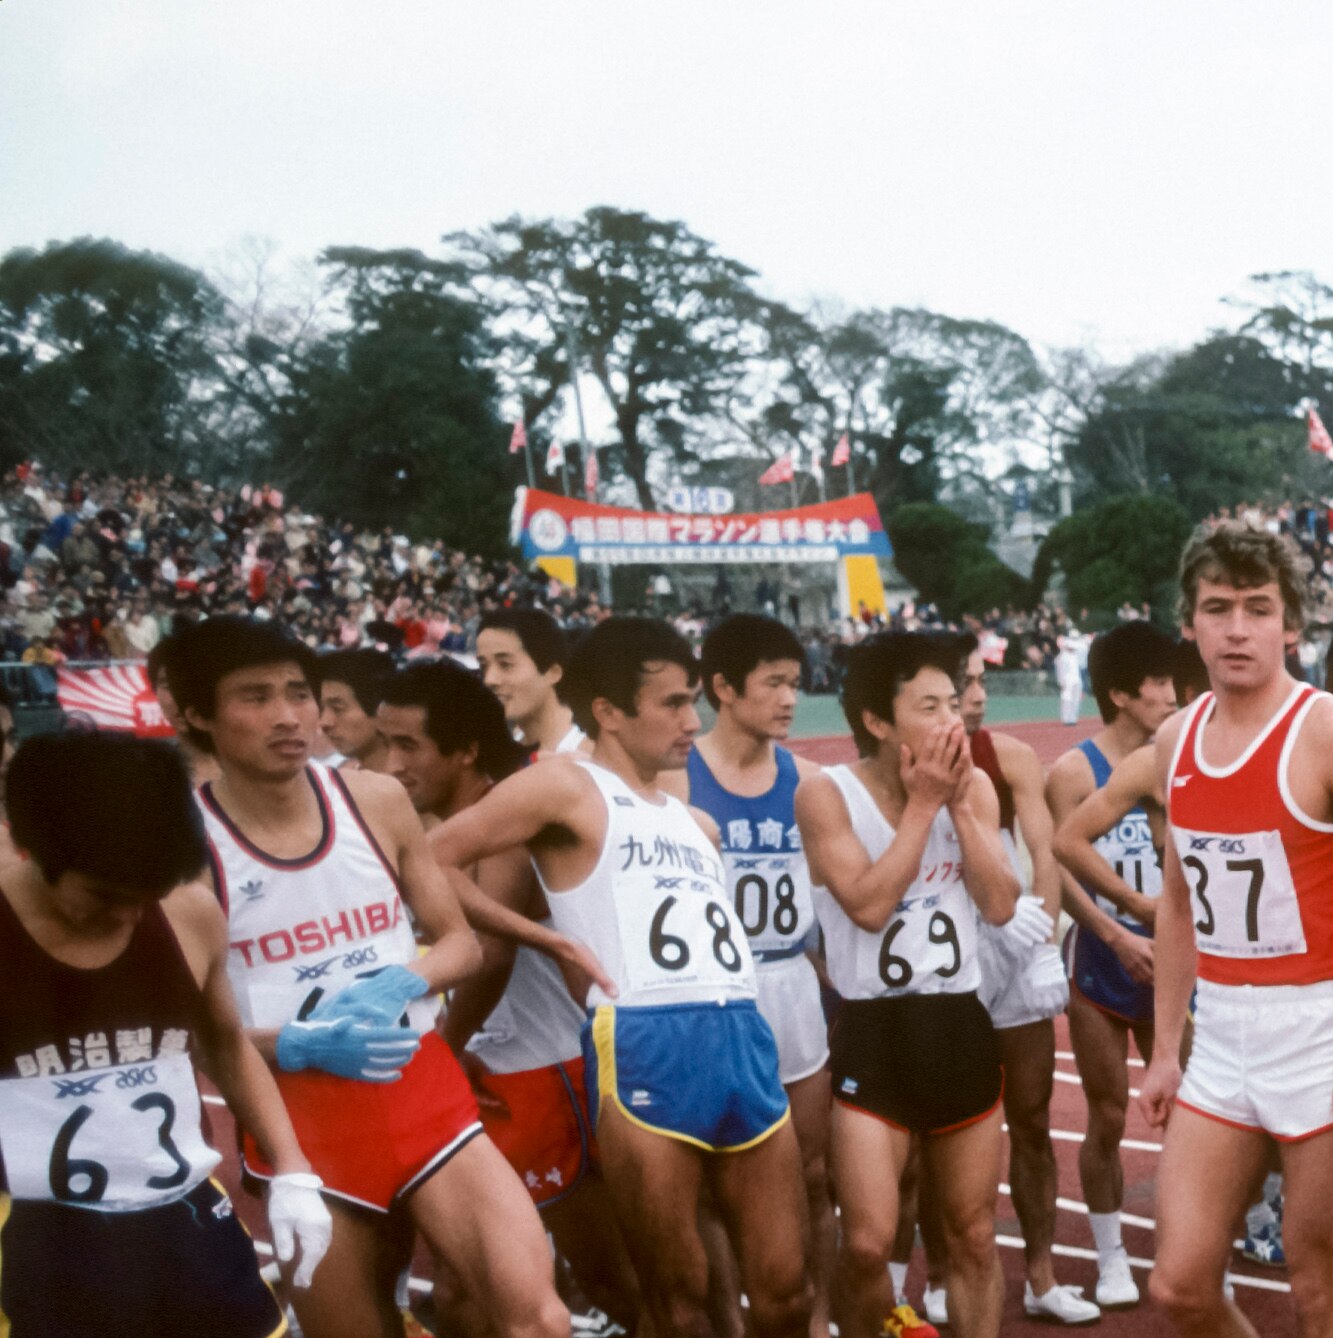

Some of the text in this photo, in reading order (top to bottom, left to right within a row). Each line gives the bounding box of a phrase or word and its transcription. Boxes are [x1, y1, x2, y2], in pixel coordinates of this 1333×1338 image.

[650, 895, 742, 973] 68
[1183, 855, 1264, 942] 37
[879, 911, 961, 988] 69
[50, 1092, 191, 1201] 63
